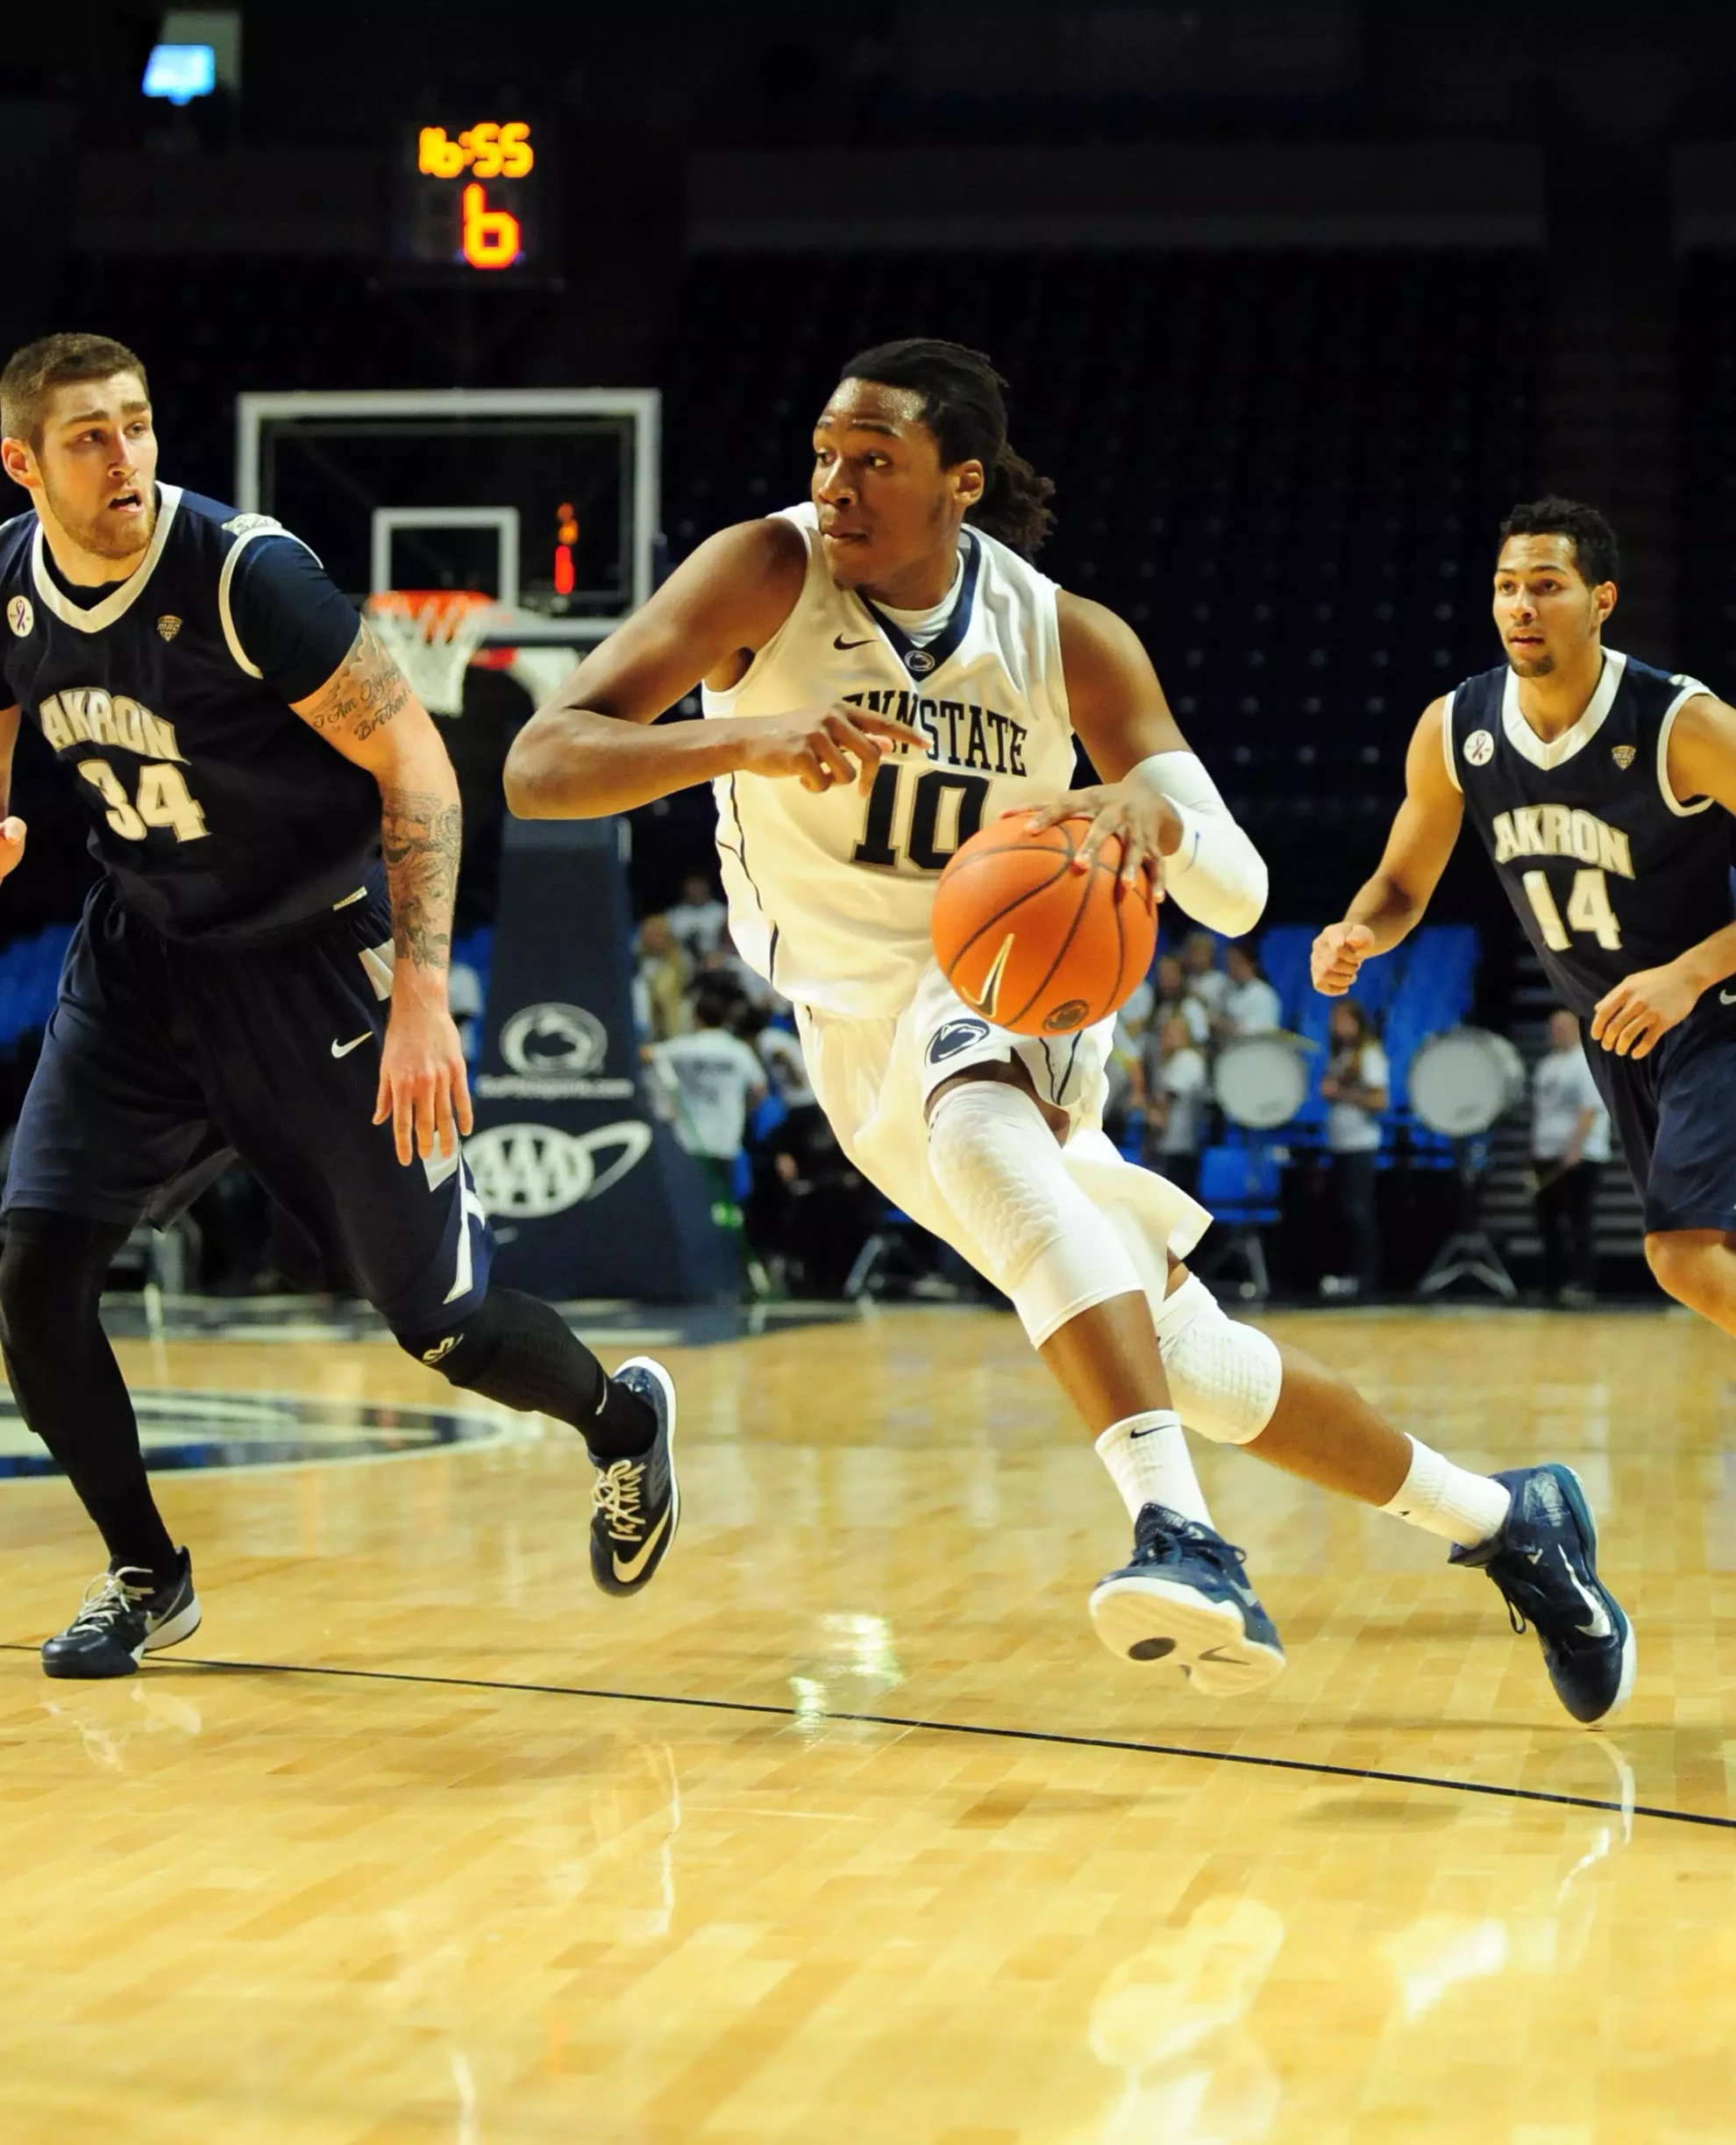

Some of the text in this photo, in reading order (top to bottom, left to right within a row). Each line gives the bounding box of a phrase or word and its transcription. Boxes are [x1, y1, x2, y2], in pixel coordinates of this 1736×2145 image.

[419, 121, 534, 179] 16:55
[463, 183, 521, 270] 6
[39, 687, 191, 766] AKRON
[920, 699, 1028, 777] STATE
[77, 759, 212, 843] 34
[850, 763, 994, 873] 10
[1493, 803, 1636, 880] AKRON
[1522, 868, 1623, 951] 14
